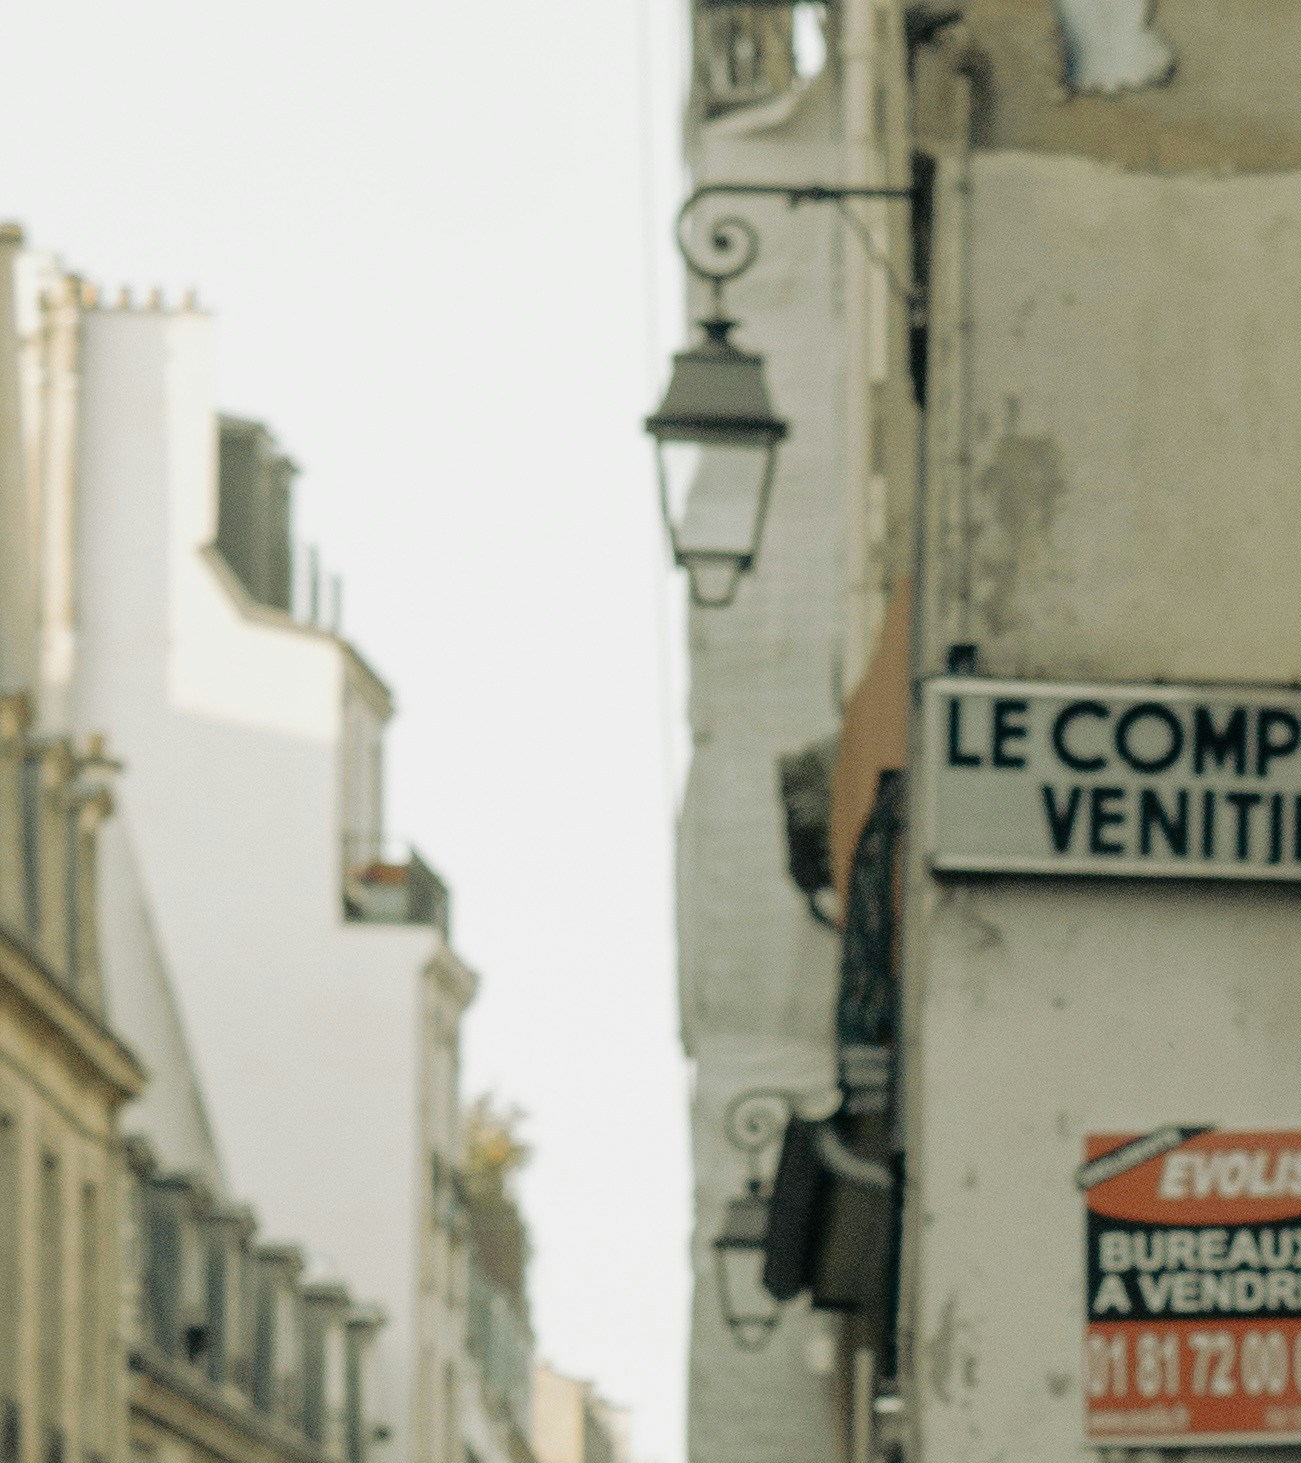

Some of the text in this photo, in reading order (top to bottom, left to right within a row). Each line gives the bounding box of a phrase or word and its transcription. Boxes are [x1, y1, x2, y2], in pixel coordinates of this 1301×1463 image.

[948, 700, 1028, 769] LE
[1087, 1331, 1128, 1397] 01
[1135, 1331, 1180, 1397] 81
[1188, 1331, 1237, 1394] 72
[1241, 1330, 1289, 1394] 00
